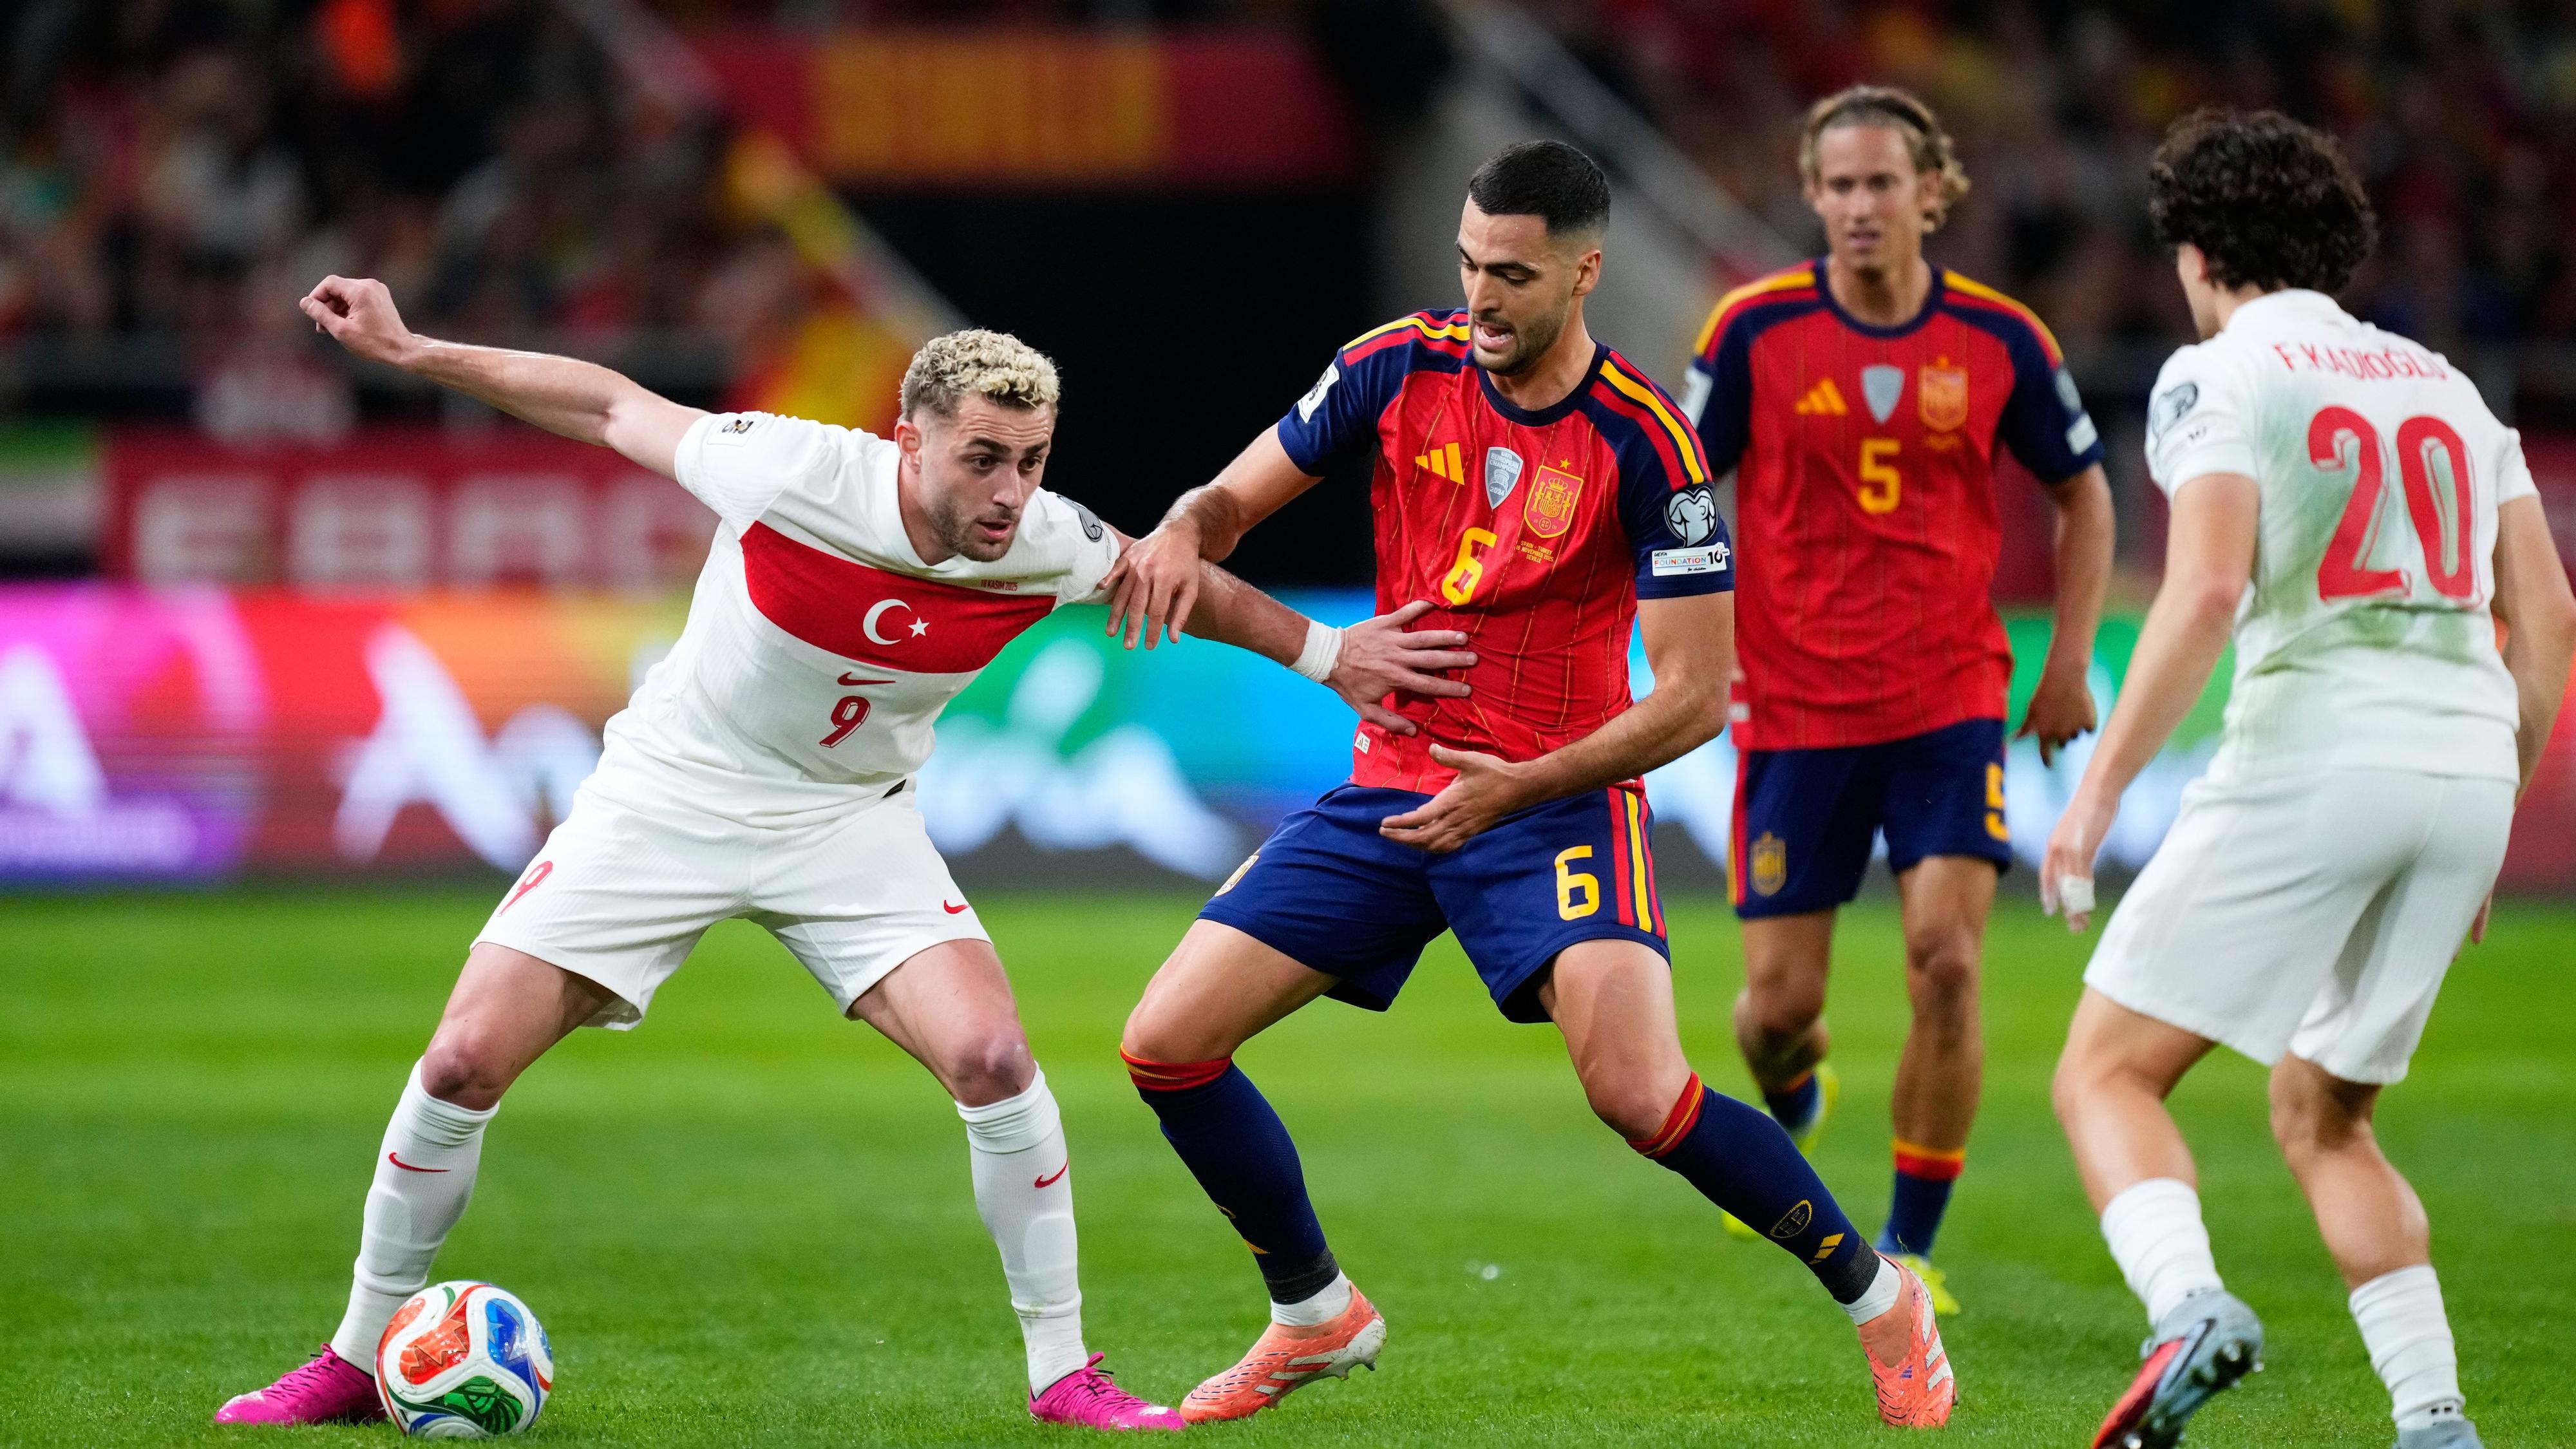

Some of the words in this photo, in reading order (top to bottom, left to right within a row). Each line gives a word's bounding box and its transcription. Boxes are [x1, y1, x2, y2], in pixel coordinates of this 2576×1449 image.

[1489, 459, 1518, 475] CHAMPIONS
[1490, 452, 1520, 469] EUROPEAN
[1859, 437, 1901, 514] 5
[1490, 486, 1505, 497] 2024
[2307, 405, 2484, 607] 20
[1520, 540, 1534, 549] SPAIN
[1538, 545, 1553, 556] TURKEY
[1521, 546, 1544, 558] NOVEMBER
[1543, 554, 1554, 562] 2025
[1441, 527, 1498, 606] 6
[1526, 554, 1542, 564] SEVILLE
[1654, 556, 1707, 566] FOUNDATION
[987, 579, 1005, 591] KASIM
[819, 696, 871, 748] 9
[497, 860, 553, 918] 9
[1554, 845, 1600, 921] 6
